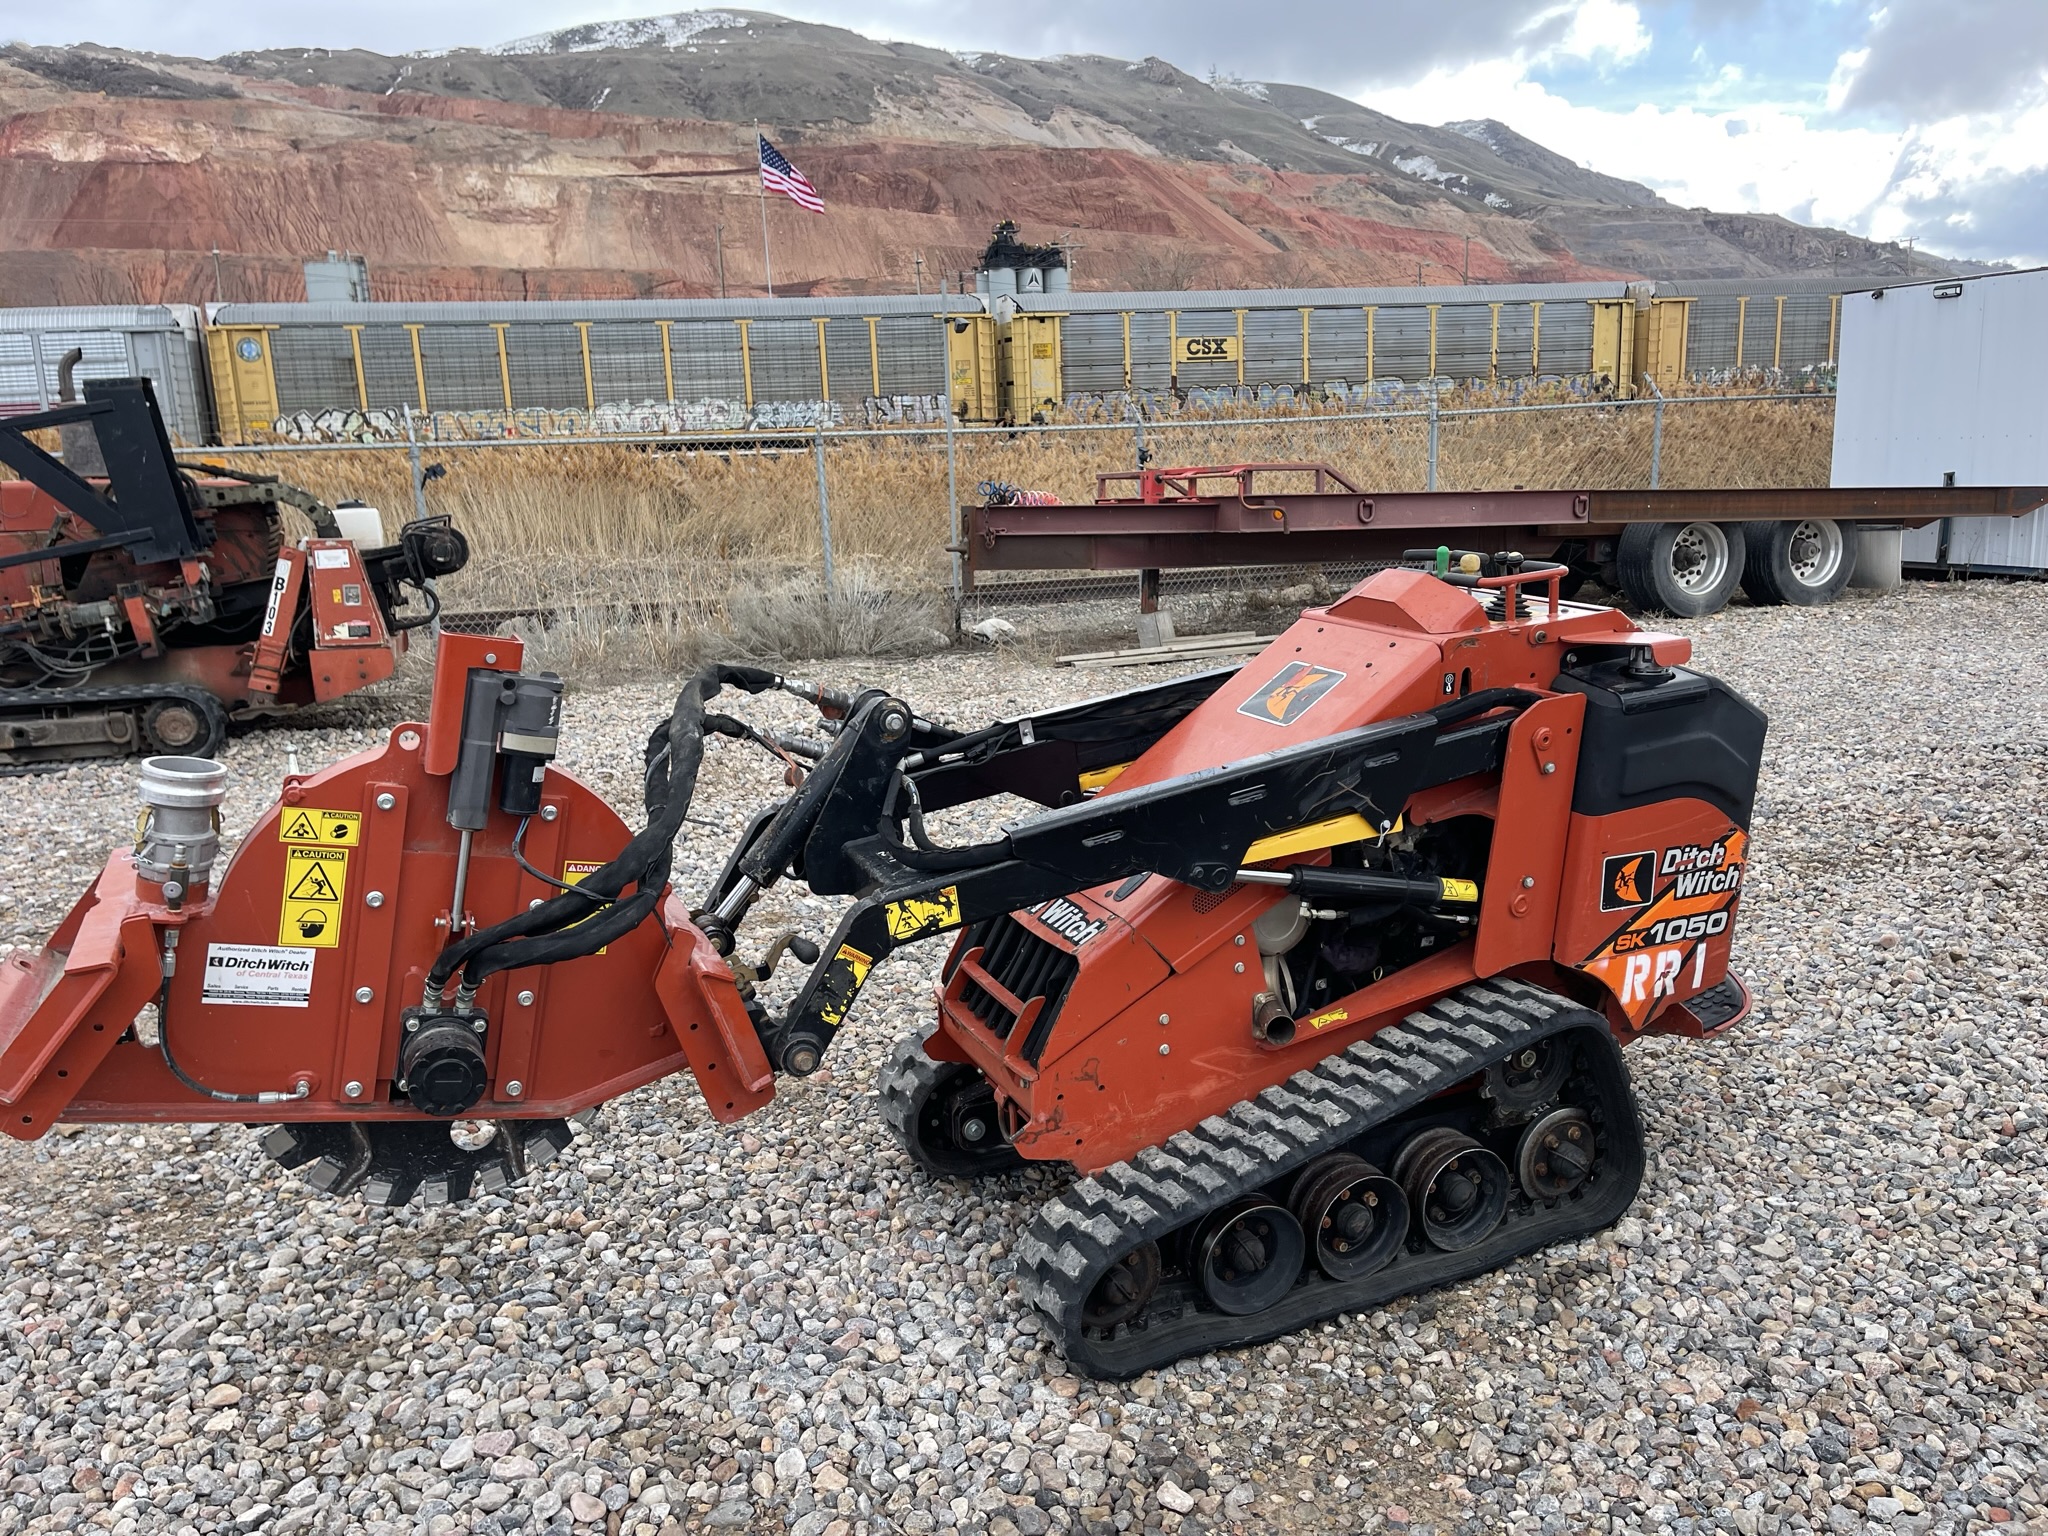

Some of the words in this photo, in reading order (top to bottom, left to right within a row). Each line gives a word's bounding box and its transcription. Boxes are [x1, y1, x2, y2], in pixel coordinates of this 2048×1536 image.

[1187, 339, 1227, 355] CSX
[330, 812, 358, 820] CAUTION
[302, 850, 343, 860] CAUTION
[1661, 842, 1725, 874] Ditch
[1676, 866, 1740, 898] Witch
[1040, 898, 1107, 945] Witch
[1616, 931, 1647, 950] SK
[1650, 911, 1728, 944] 1050
[248, 970, 280, 978] Central
[283, 972, 308, 980] Texas
